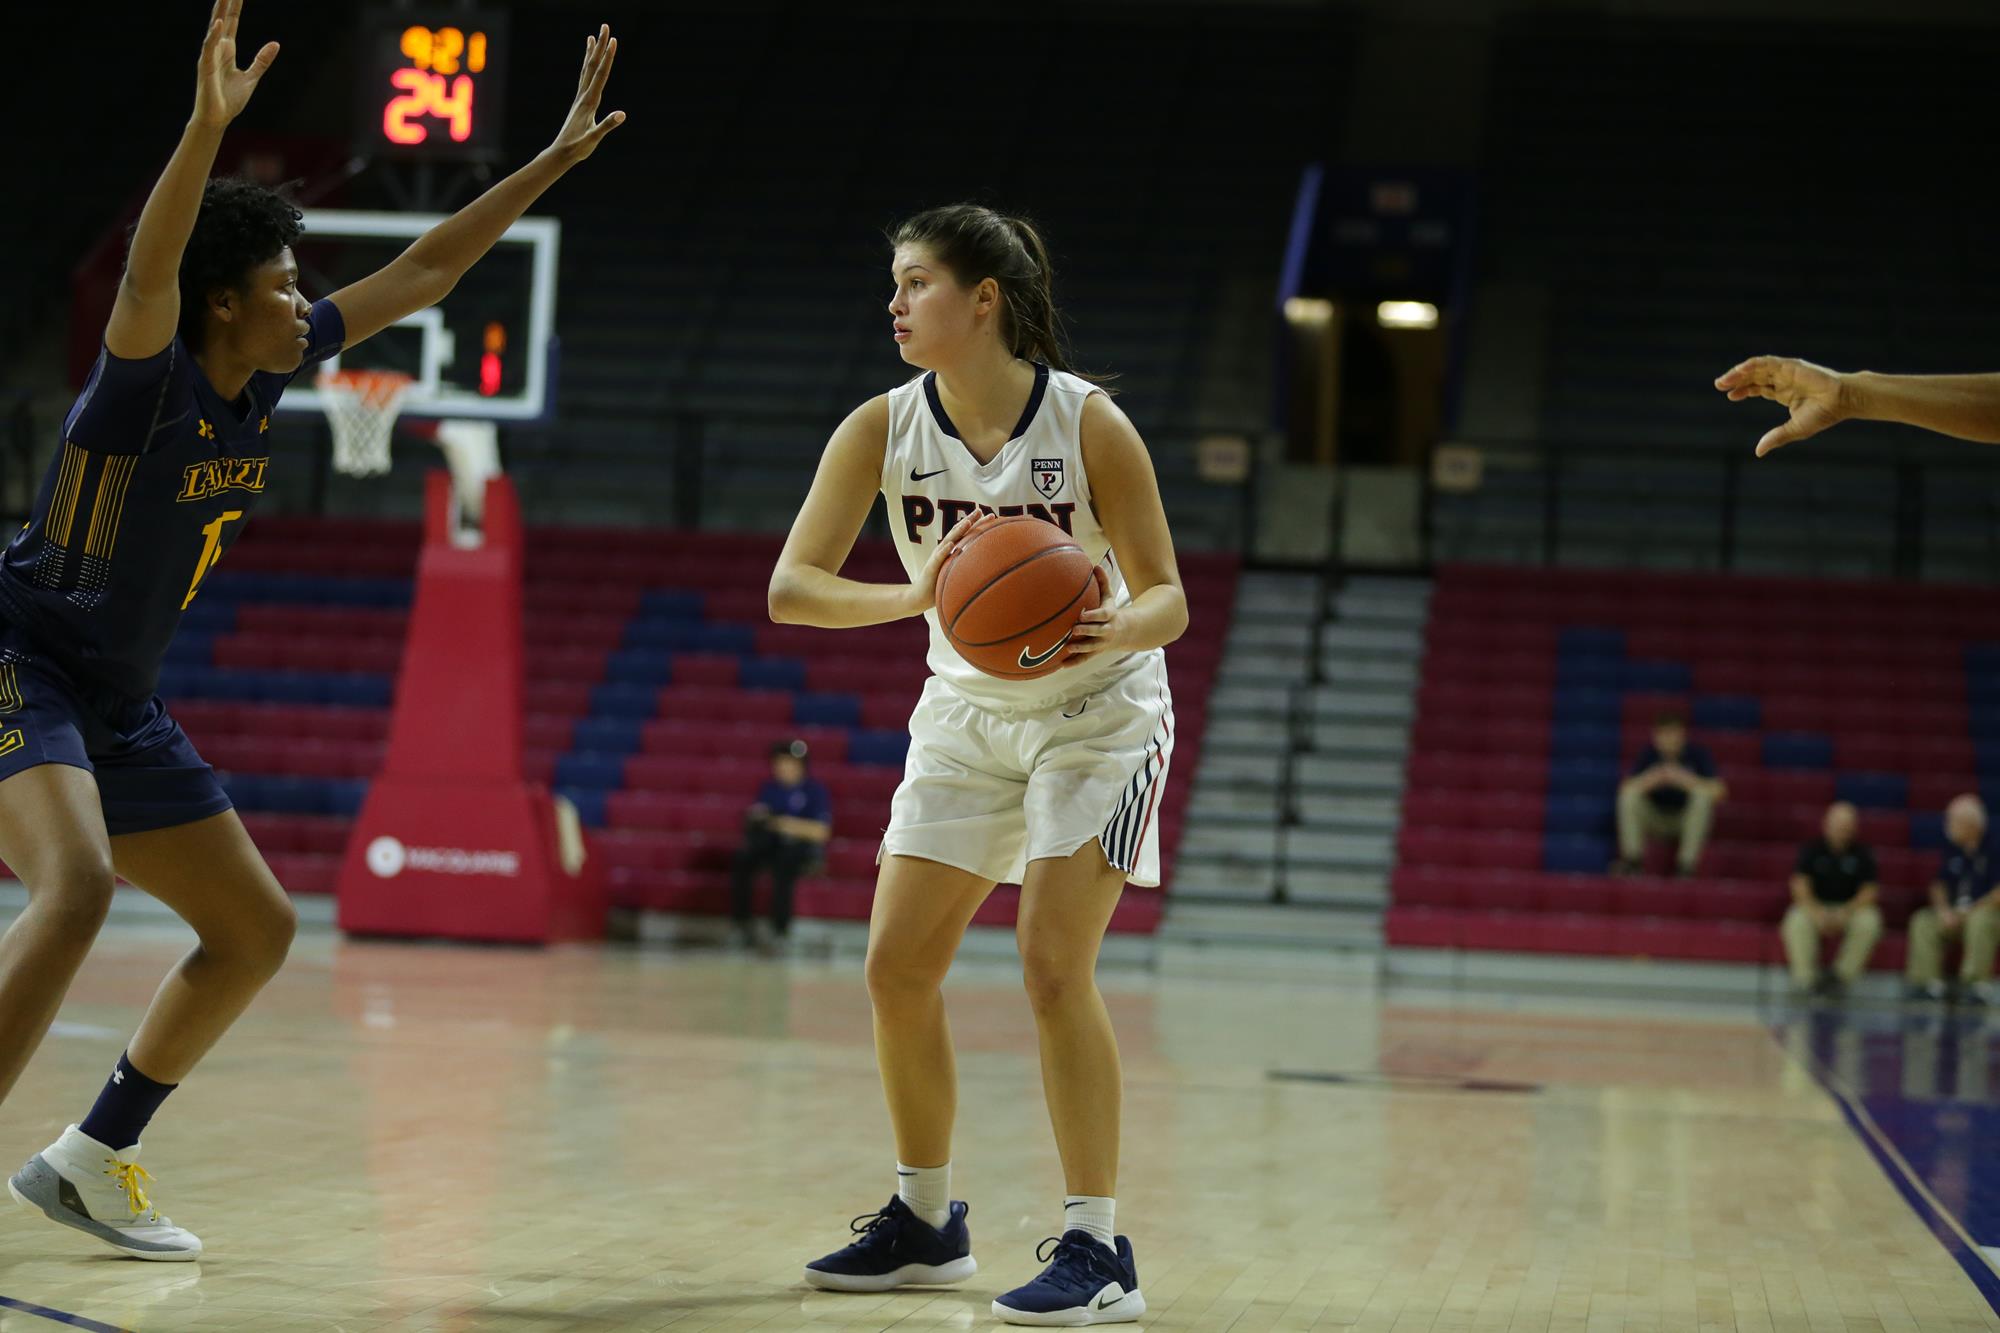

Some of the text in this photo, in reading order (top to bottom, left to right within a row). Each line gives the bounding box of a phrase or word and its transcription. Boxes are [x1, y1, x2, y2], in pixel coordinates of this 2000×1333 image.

[383, 68, 474, 145] 24
[1034, 460, 1061, 469] PENN
[1041, 472, 1056, 491] P
[902, 495, 1075, 545] PEN
